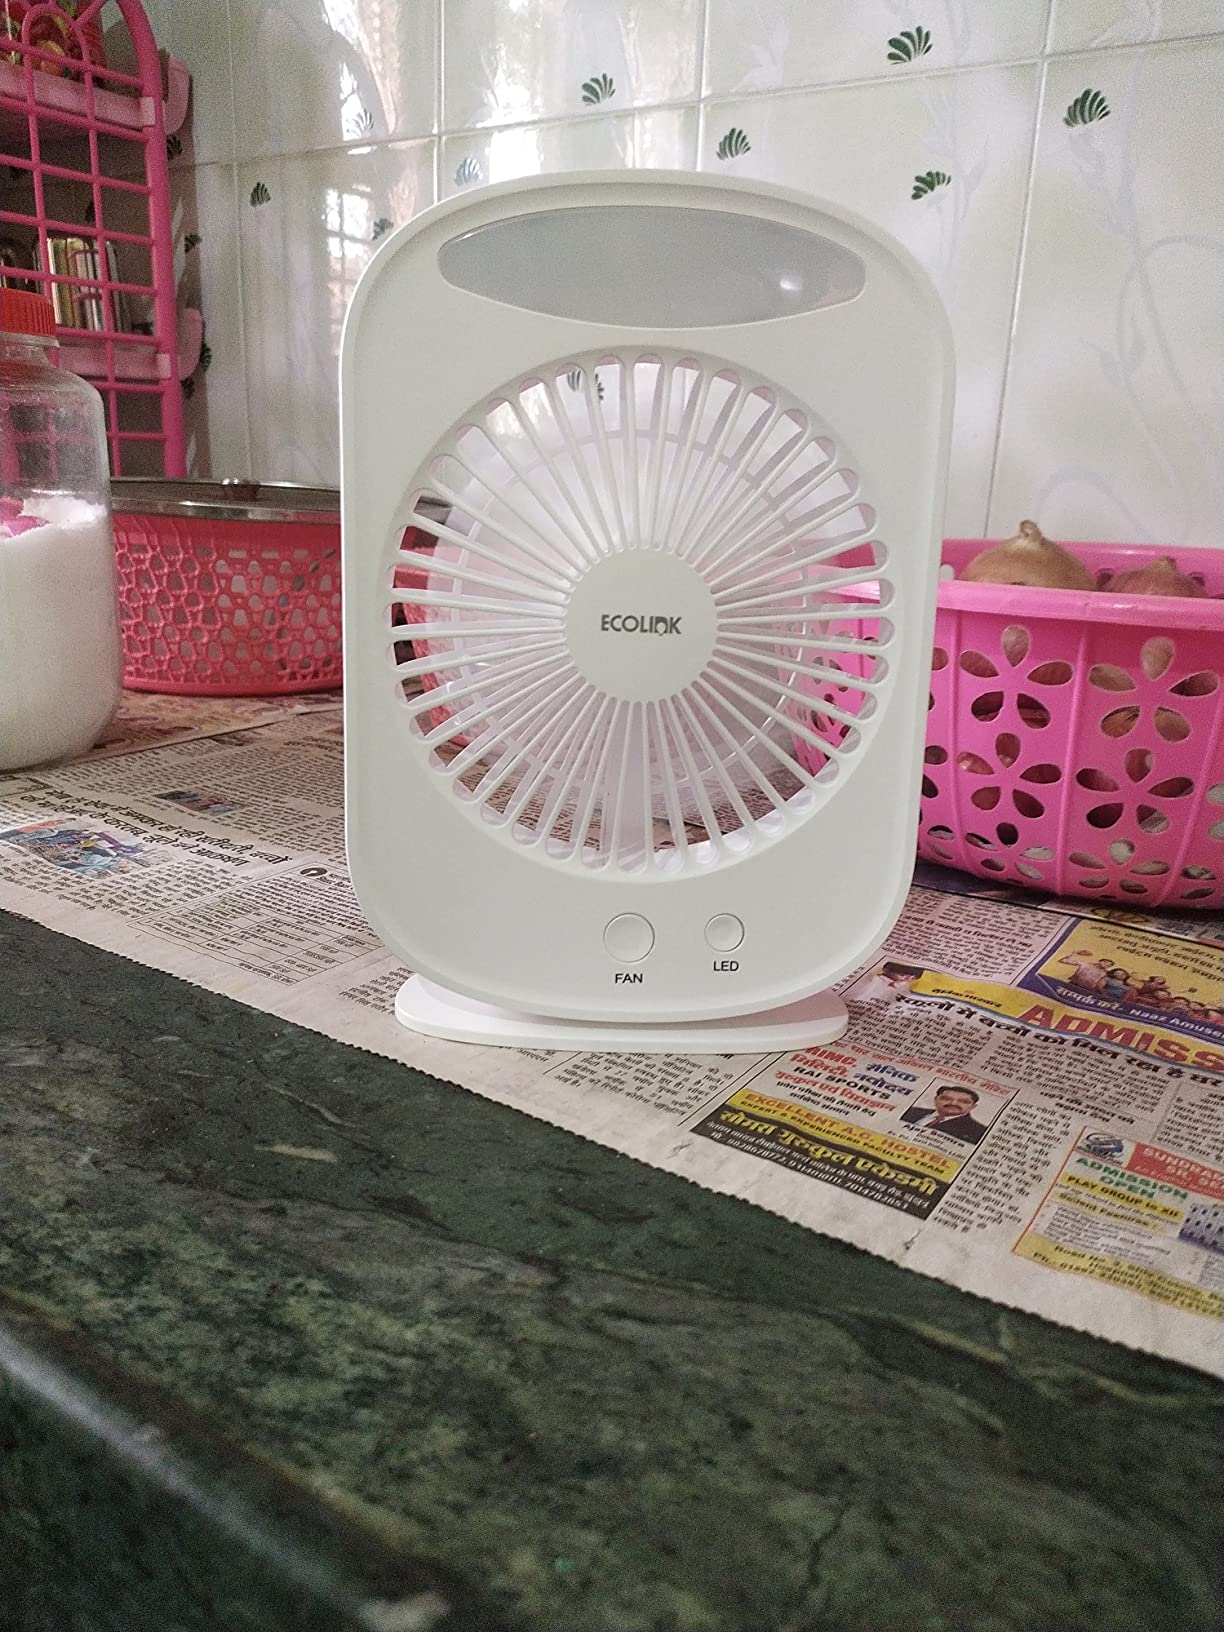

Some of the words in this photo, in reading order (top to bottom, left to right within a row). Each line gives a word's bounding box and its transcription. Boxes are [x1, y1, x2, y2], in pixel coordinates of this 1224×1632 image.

[614, 973, 643, 984] FAN
[713, 960, 739, 972] LED
[1130, 1007, 1166, 1024] Naaz
[1034, 1031, 1068, 1046] को
[793, 1066, 824, 1079] RAI
[825, 1074, 892, 1100] SPORTS
[745, 1092, 837, 1129] EXCELLENT
[879, 1138, 951, 1169] HOSTEL
[856, 1157, 938, 1196] एकेडमी
[1067, 1174, 1098, 1190] PLAY
[1100, 1186, 1142, 1205] GROUP
[1076, 1157, 1188, 1199] ADMISSION
[1100, 1175, 1155, 1198] OPEN
